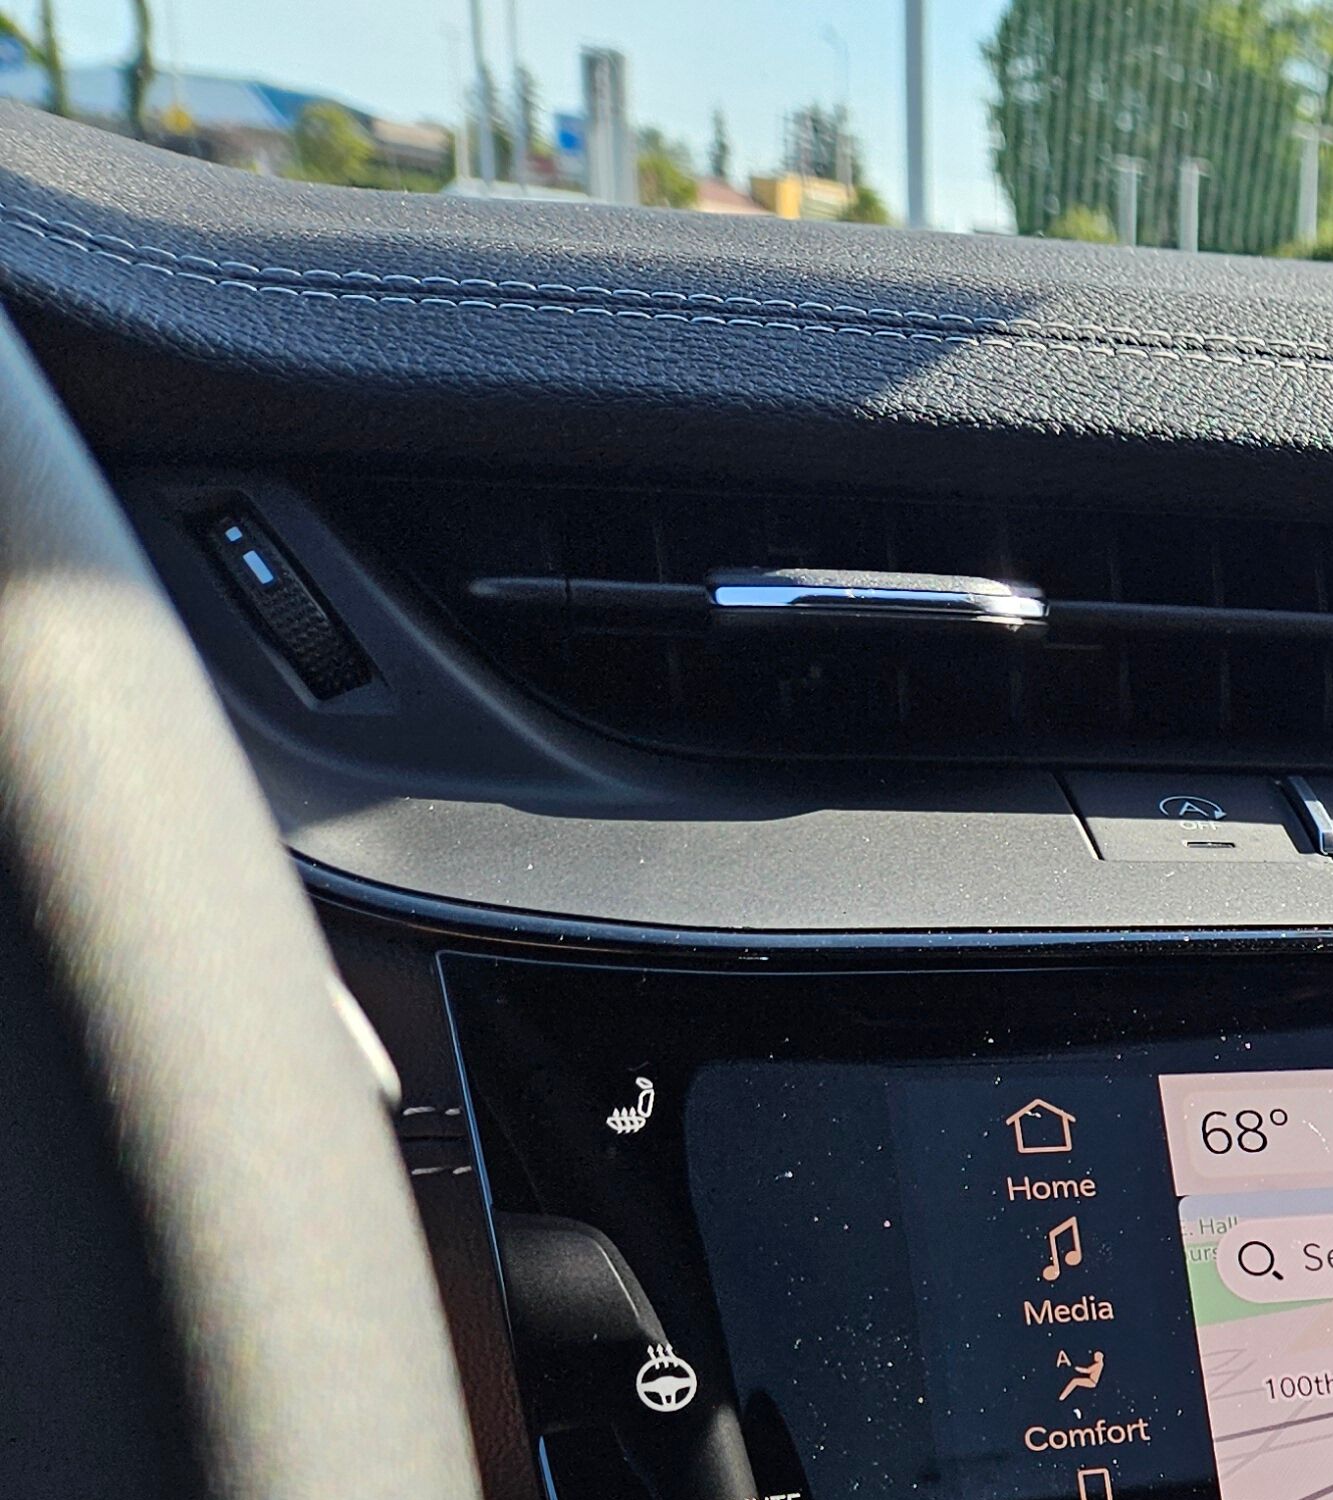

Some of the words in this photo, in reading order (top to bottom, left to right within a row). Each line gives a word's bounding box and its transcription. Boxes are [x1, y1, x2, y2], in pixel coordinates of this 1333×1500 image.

[1006, 1175, 1097, 1201] Home
[1023, 1295, 1115, 1326] Media
[1023, 1418, 1151, 1452] Comfort
